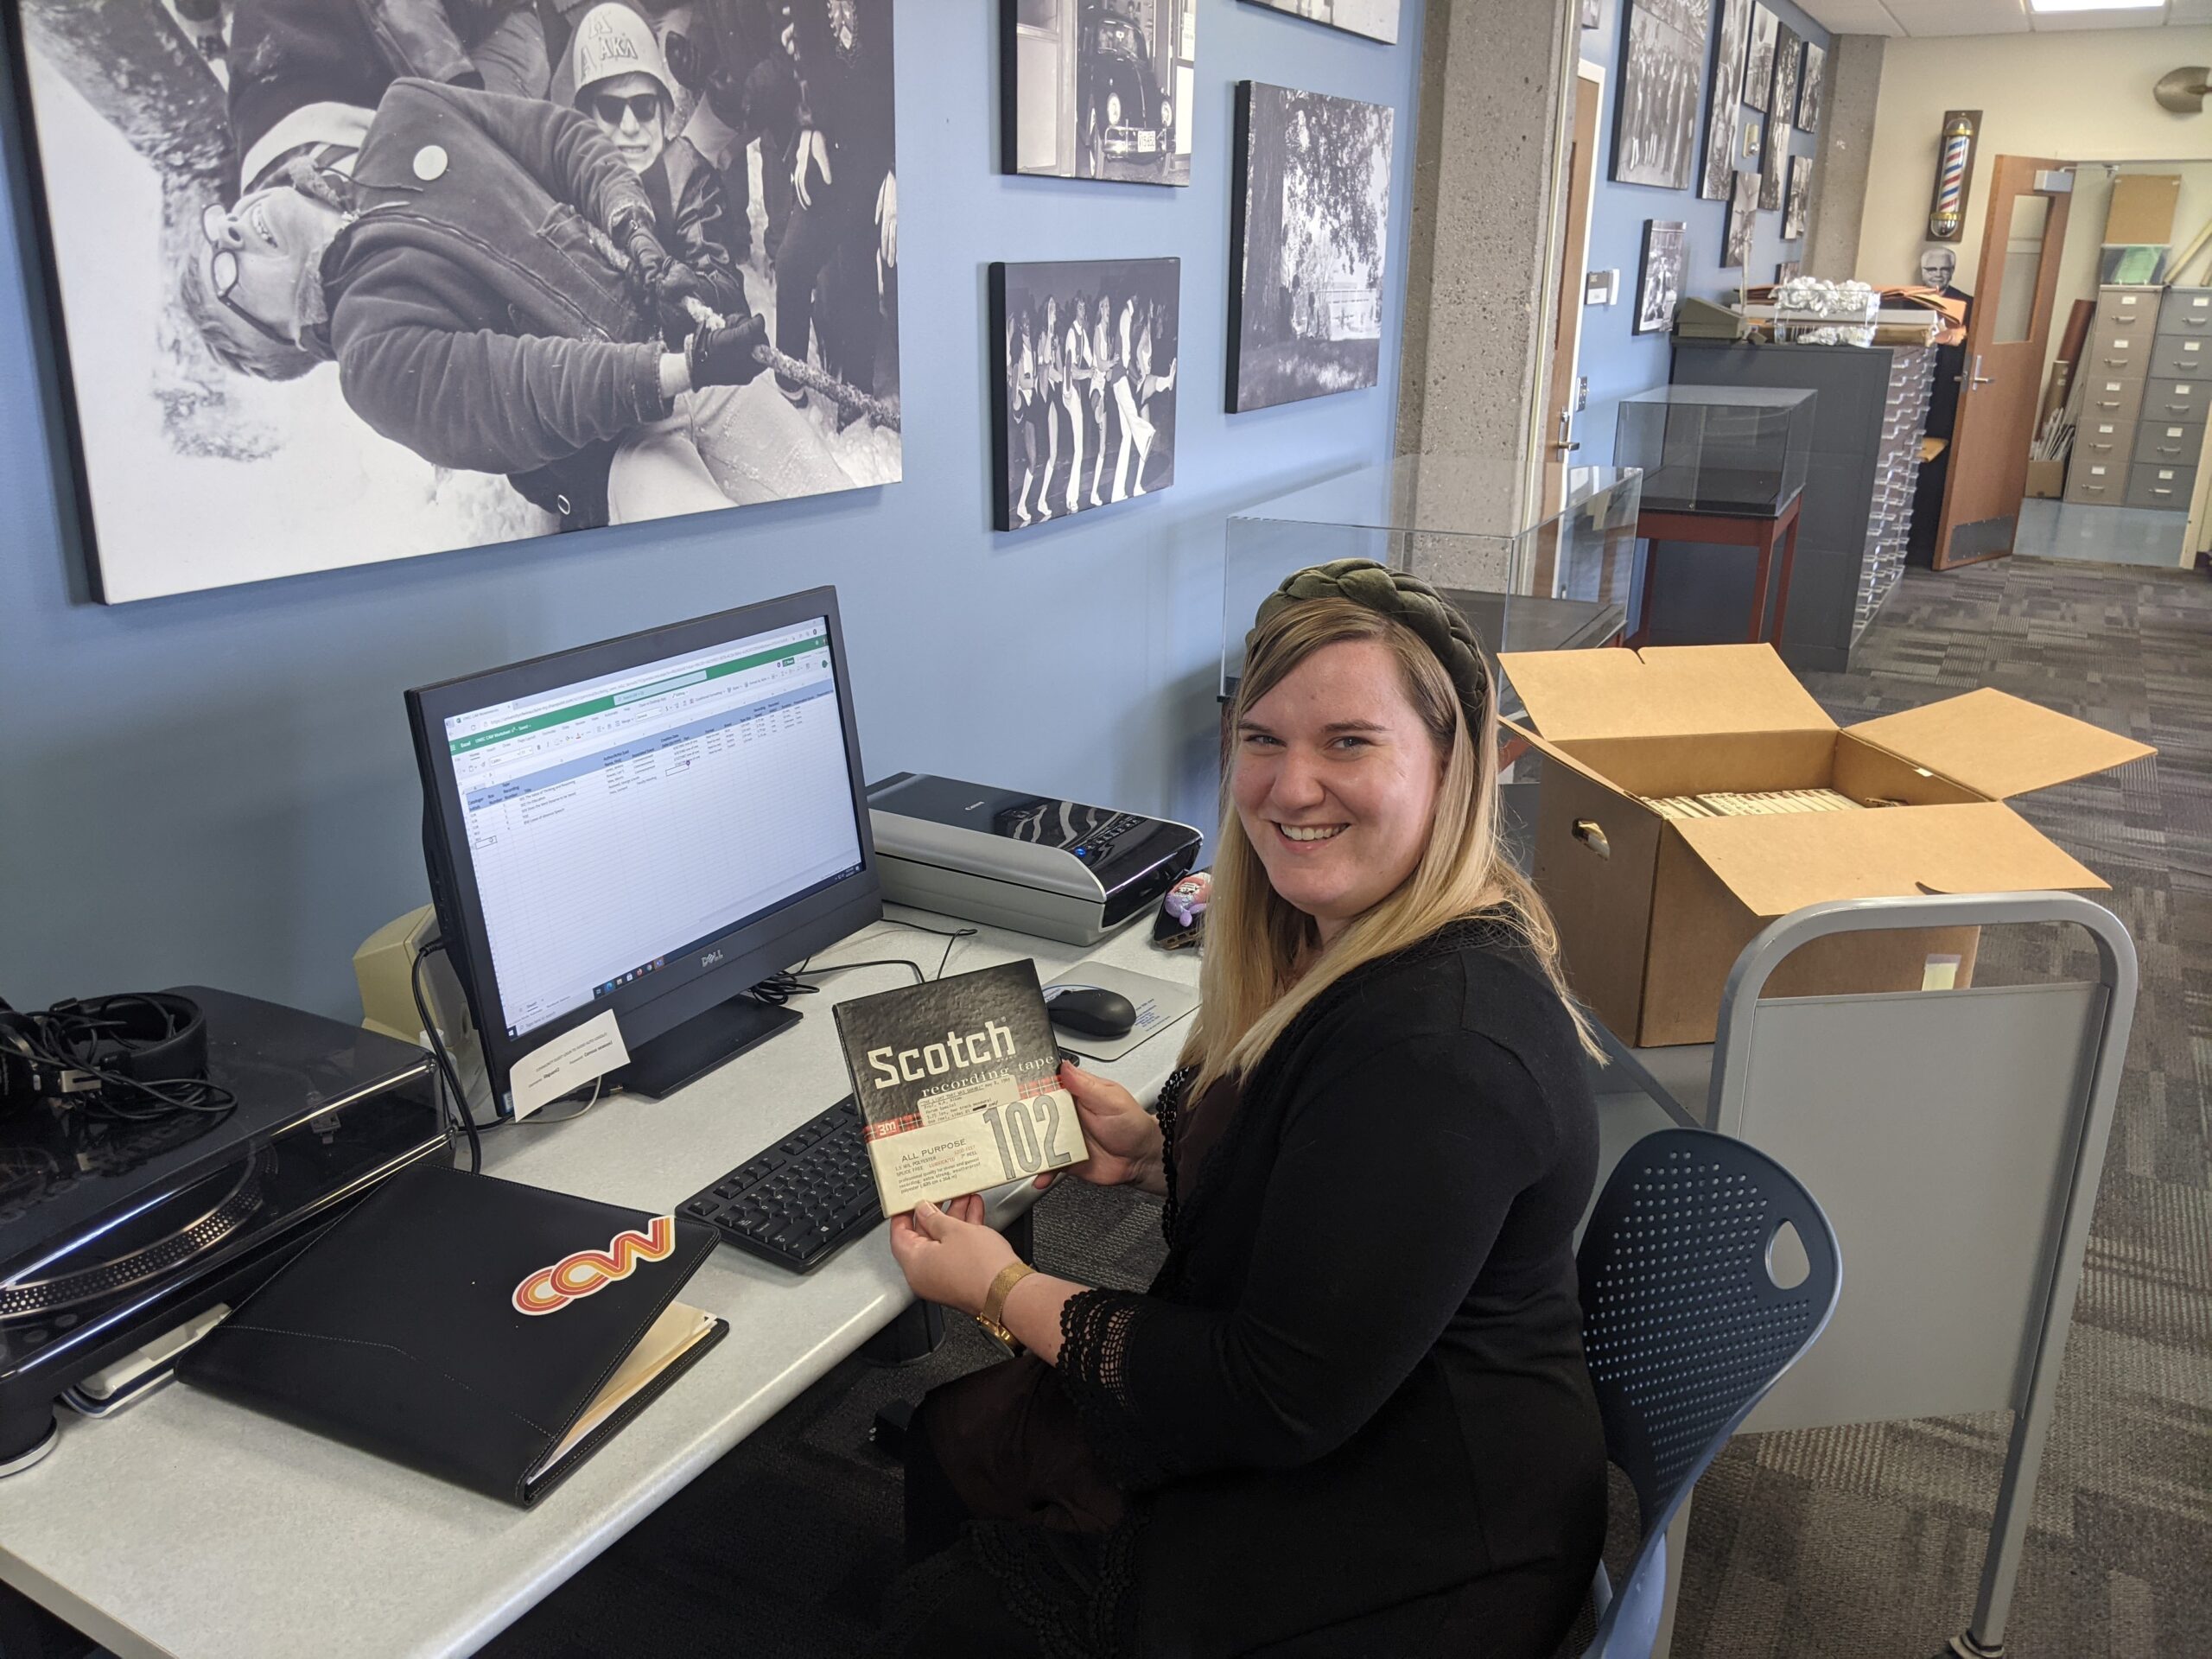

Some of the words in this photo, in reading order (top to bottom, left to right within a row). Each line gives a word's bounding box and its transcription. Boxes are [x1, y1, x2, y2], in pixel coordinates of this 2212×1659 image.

[868, 1020, 1016, 1090] Scotch
[921, 1066, 1010, 1096] recording
[1018, 1055, 1054, 1072] tape
[901, 1153, 918, 1162] ALL
[921, 1139, 966, 1156] PURPOSE
[982, 1094, 1071, 1180] 102
[912, 1157, 936, 1166] POLYESTER
